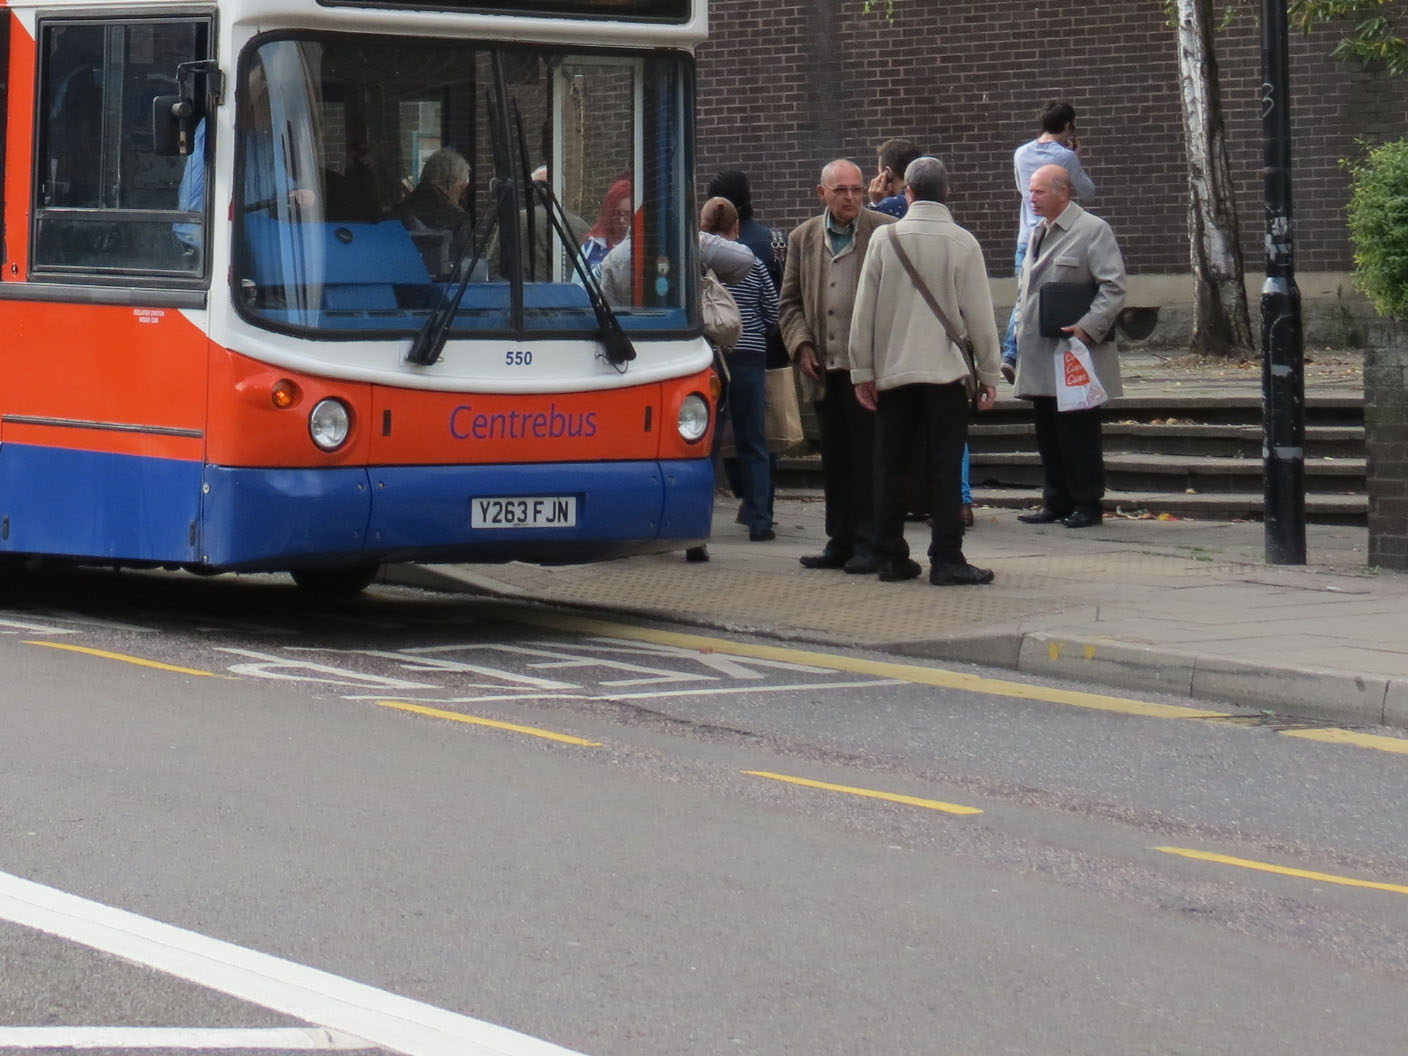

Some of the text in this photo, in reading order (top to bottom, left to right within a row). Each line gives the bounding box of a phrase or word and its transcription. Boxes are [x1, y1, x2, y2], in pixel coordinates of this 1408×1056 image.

[505, 351, 533, 366] 550
[450, 403, 597, 440] Centrebus
[479, 500, 569, 524] Y263 FJN
